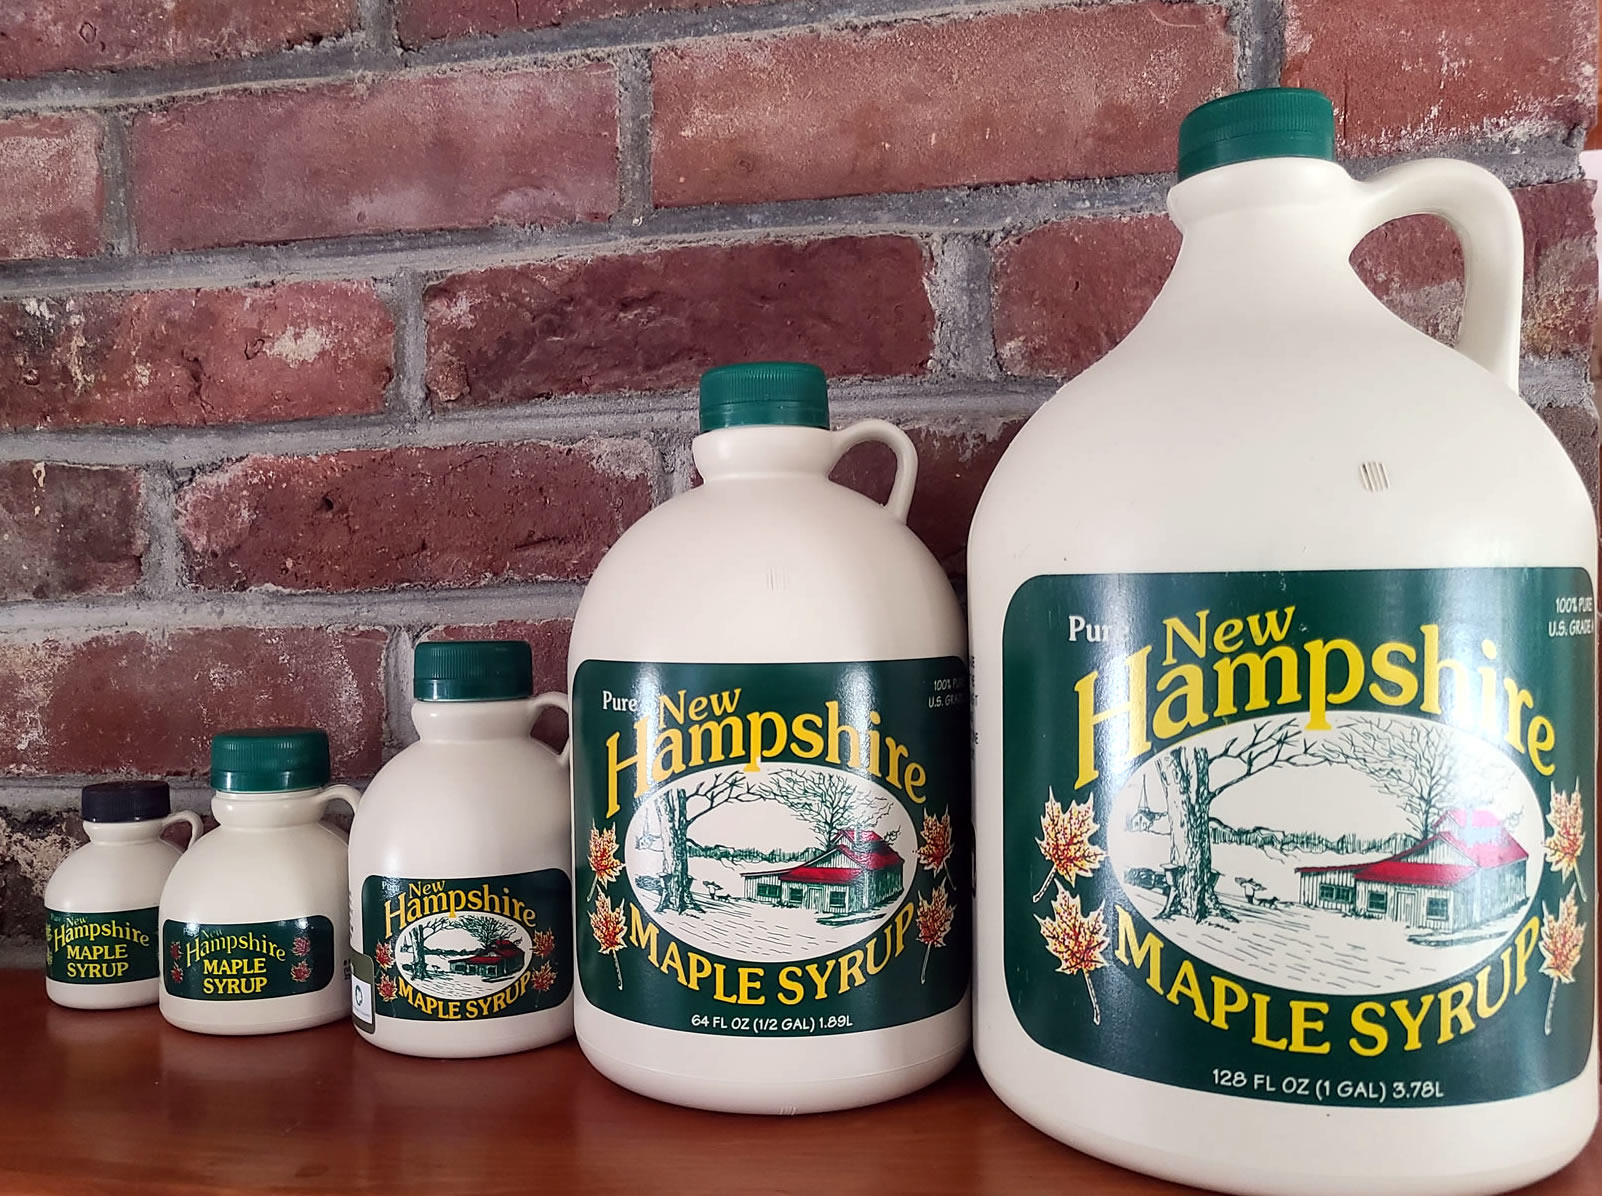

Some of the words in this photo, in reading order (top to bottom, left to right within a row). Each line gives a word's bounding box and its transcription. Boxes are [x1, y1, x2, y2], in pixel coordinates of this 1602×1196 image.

[1555, 597, 1577, 614] 100%
[1162, 605, 1296, 666] New
[1548, 620, 1568, 637] U.S.
[602, 690, 638, 712] Pure
[658, 688, 742, 729] New
[1072, 624, 1557, 790] Hampshire
[605, 700, 927, 819] Hampshire
[408, 880, 446, 897] New
[66, 916, 88, 928] New
[384, 884, 537, 939] Hampshire
[53, 919, 150, 953] Hampshire
[66, 944, 129, 960] MAPLE
[186, 931, 286, 968] Hampshire
[67, 962, 129, 978] SYRUP
[203, 957, 267, 975] MAPLE
[629, 903, 766, 1005] MAPLE
[778, 903, 915, 1005] SYRUP
[203, 977, 268, 994] SYRUP
[398, 977, 461, 1020] MAPLE
[465, 971, 532, 1019] SYRUP
[1114, 905, 1331, 1054] MAPLE
[1349, 915, 1541, 1056] SYRUP
[691, 1014, 710, 1027] 64
[712, 1016, 728, 1029] FL
[731, 1017, 750, 1031] OZ
[753, 1017, 778, 1033] (1/2
[781, 1017, 815, 1033] GAL)
[819, 1015, 853, 1029] 1.89L
[1212, 1068, 1248, 1088] 128
[1253, 1073, 1276, 1092] FL
[1282, 1077, 1310, 1095] OZ
[1315, 1079, 1331, 1101] (1
[1337, 1081, 1387, 1103] GAL)
[1392, 1081, 1444, 1099] 3.78L
